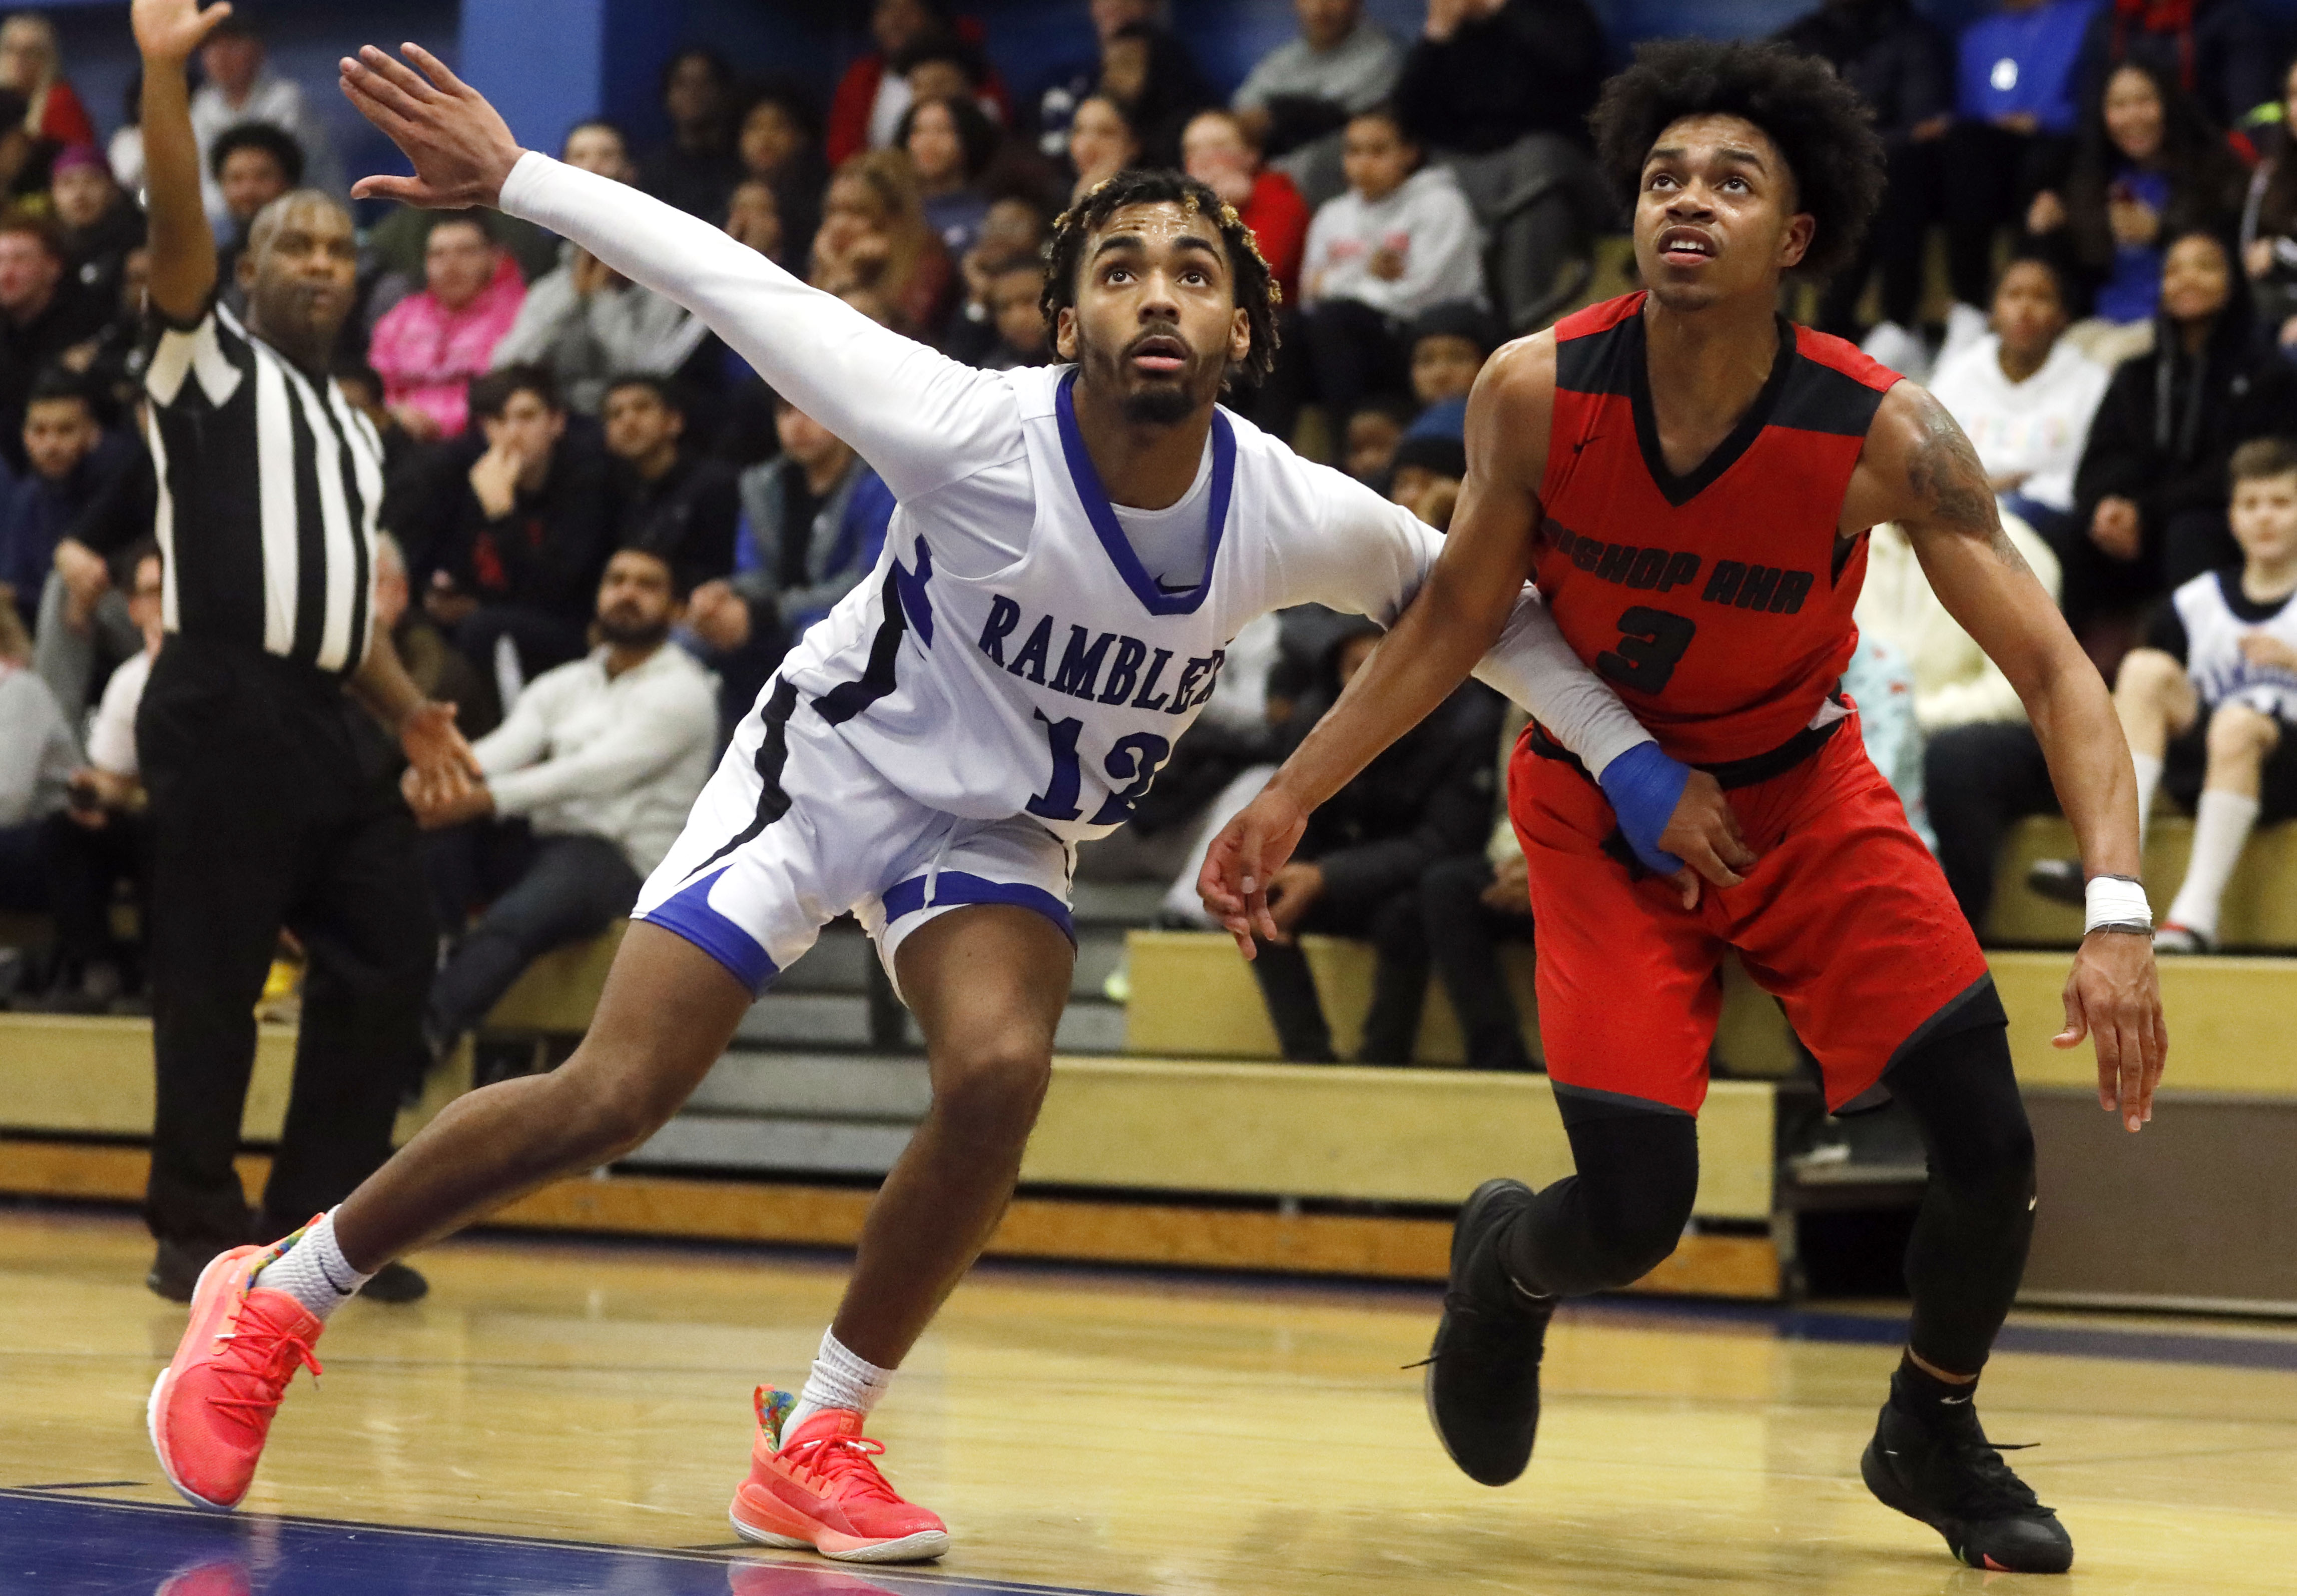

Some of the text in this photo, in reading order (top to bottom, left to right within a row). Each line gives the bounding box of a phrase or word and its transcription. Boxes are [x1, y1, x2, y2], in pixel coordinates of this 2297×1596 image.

[1701, 560, 1814, 615] AHR
[978, 594, 1235, 715] RAMBLER
[1596, 605, 1696, 696] 3
[1024, 706, 1170, 826] 12
